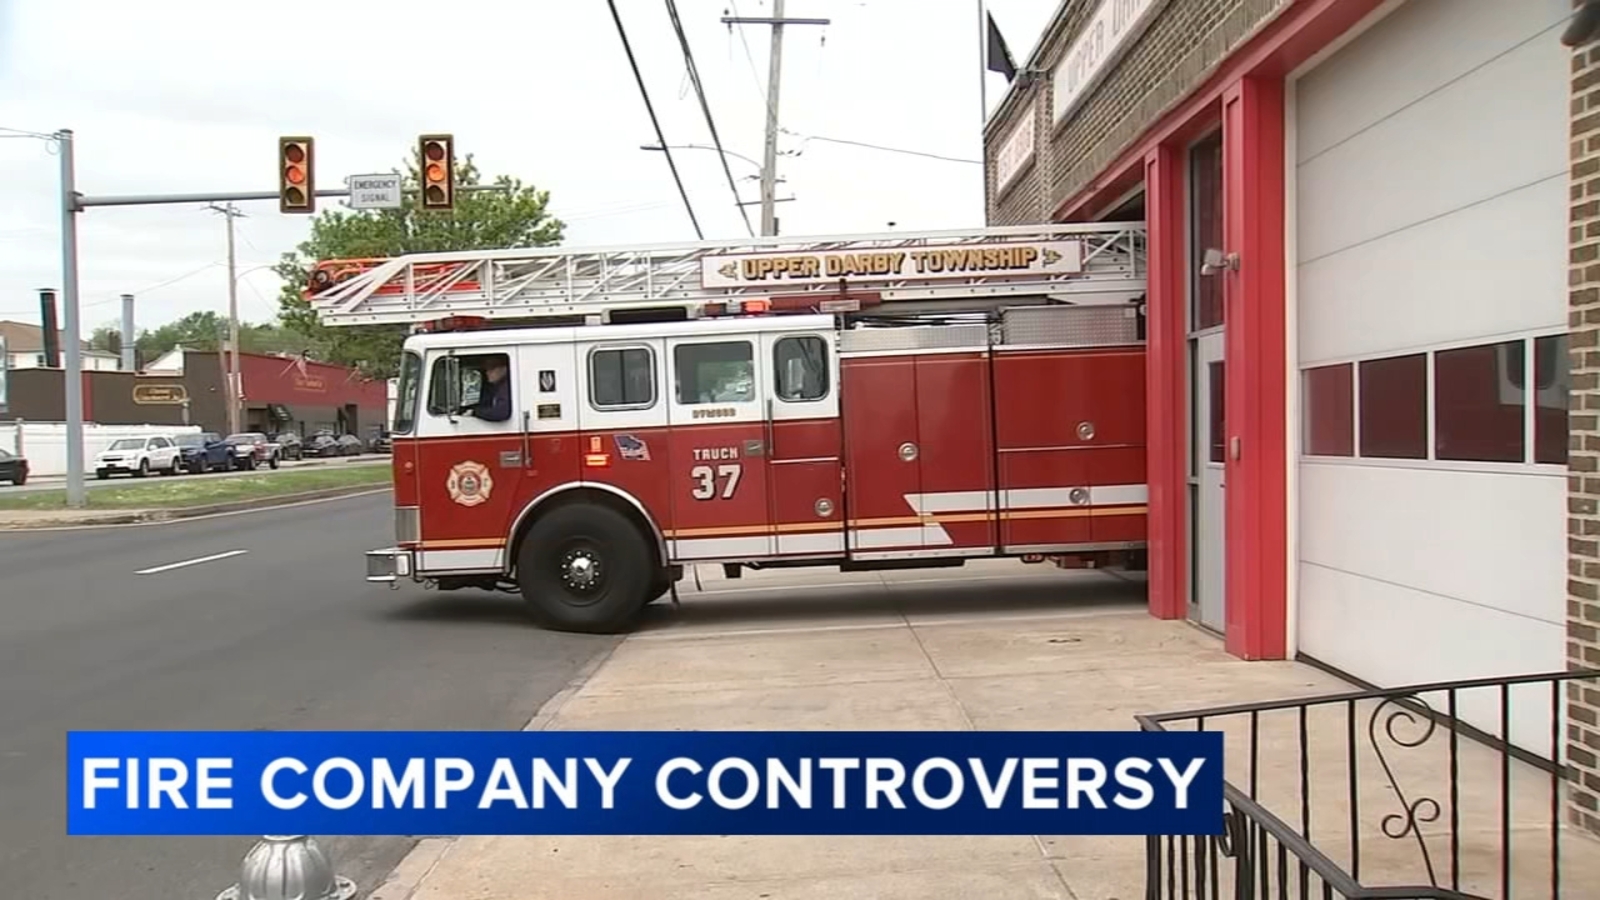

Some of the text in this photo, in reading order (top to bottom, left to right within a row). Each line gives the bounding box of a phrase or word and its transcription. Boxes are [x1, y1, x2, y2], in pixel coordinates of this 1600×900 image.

[1067, 19, 1105, 93] UPPER
[354, 179, 396, 190] EMERGENCY
[361, 193, 394, 203] SIGNAL
[742, 247, 1037, 282] UPPER DARBY TOWNSHIP
[692, 446, 738, 460] TRUCK
[692, 464, 742, 500] 37
